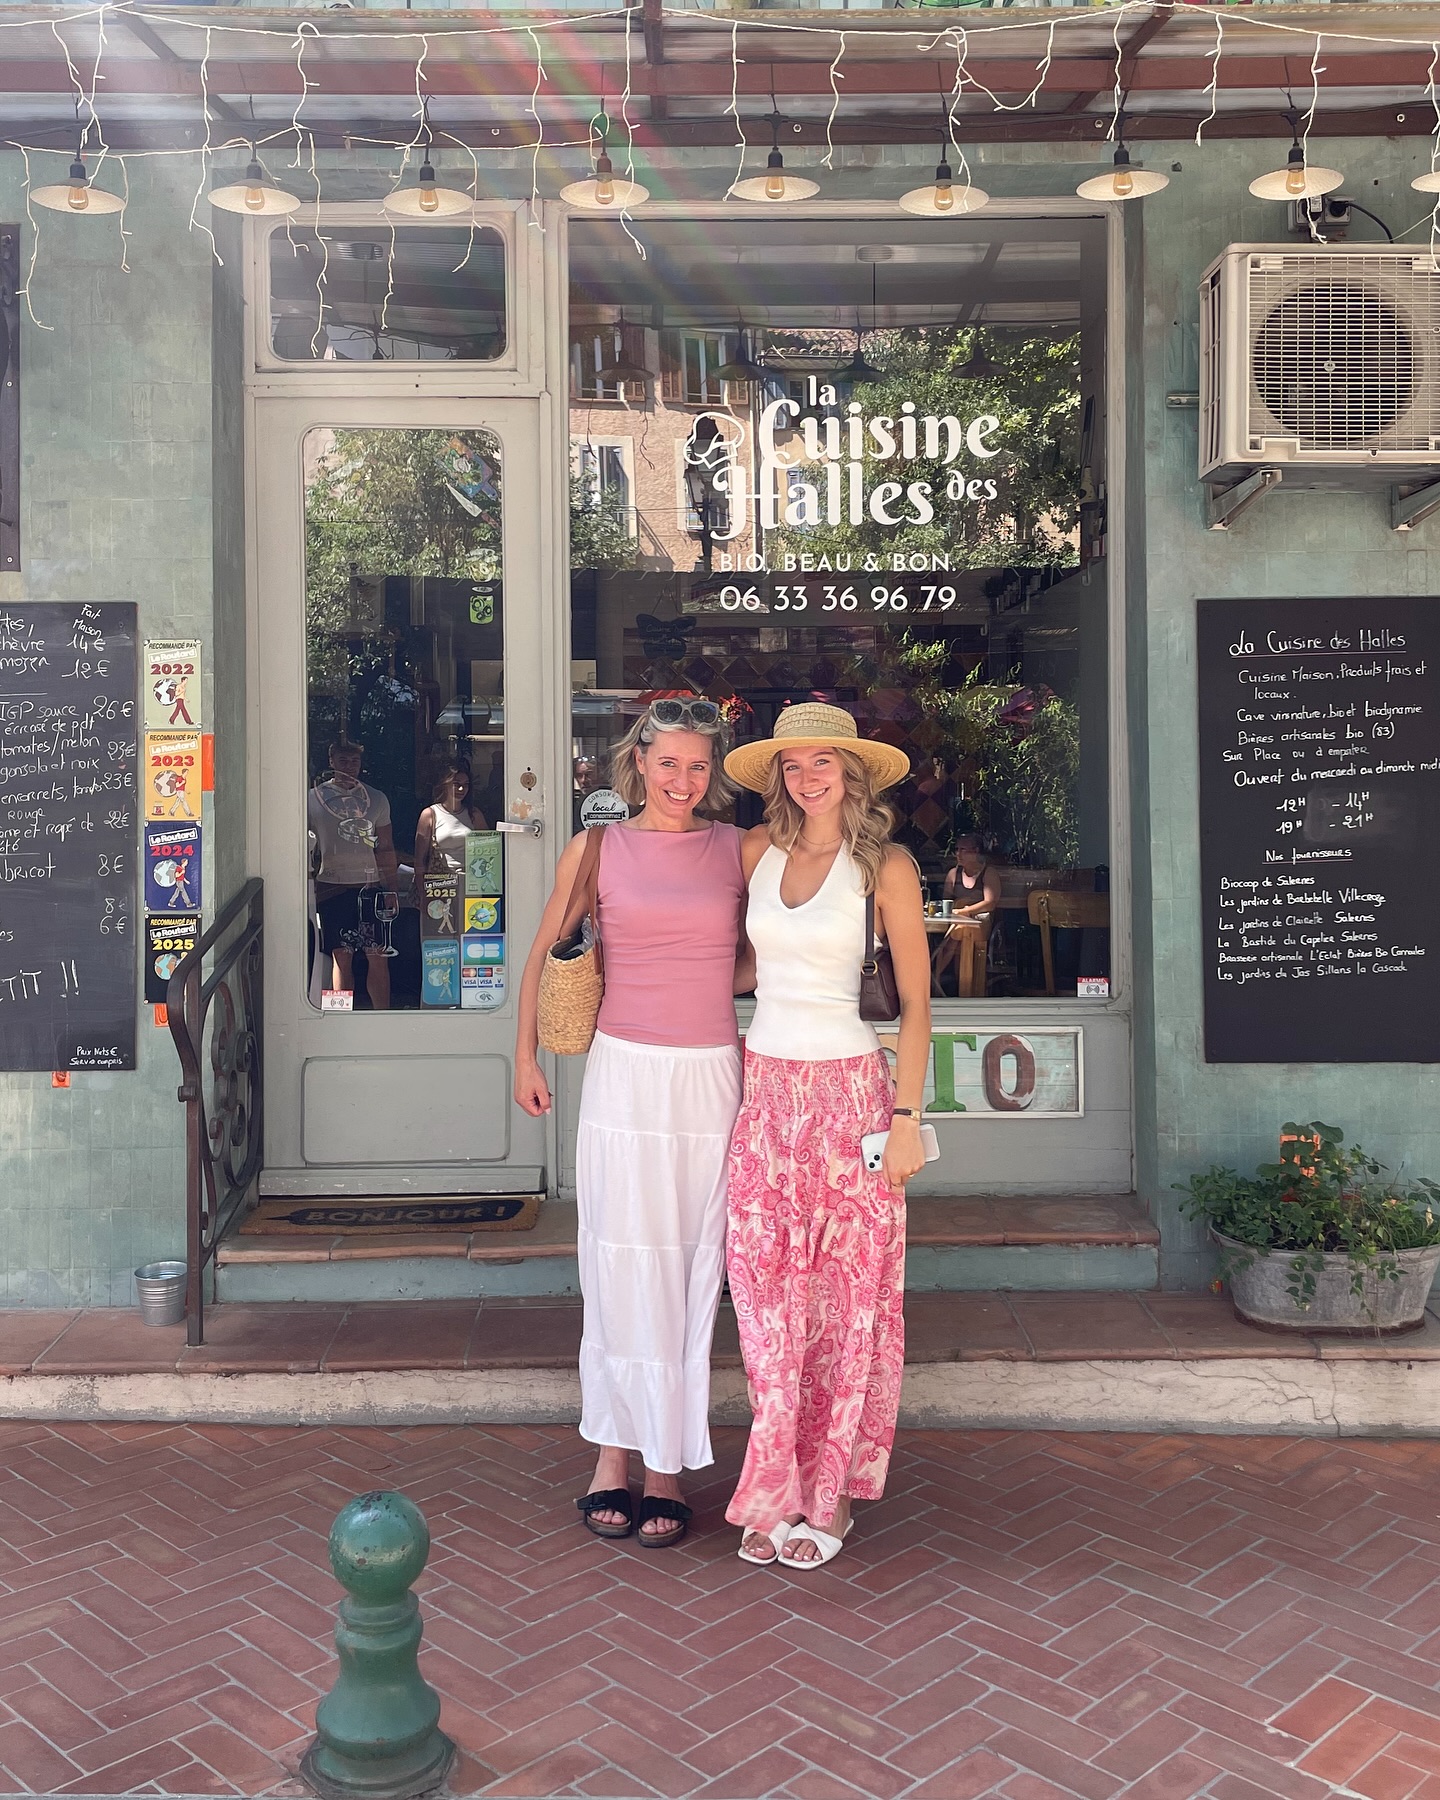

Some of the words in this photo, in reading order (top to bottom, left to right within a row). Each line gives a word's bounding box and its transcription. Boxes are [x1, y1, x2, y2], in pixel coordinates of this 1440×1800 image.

[807, 375, 838, 406] la
[759, 399, 1002, 469] Cuisine
[946, 470, 998, 501] des
[710, 460, 934, 540] Halles
[720, 553, 771, 575] BIO,
[784, 553, 851, 572] BEAU
[864, 553, 880, 572] &
[893, 553, 957, 572] BON.
[720, 586, 760, 612] 06
[774, 586, 808, 612] 33
[822, 586, 858, 612] 36
[870, 586, 906, 612] 96
[920, 586, 957, 612] 79
[81, 604, 101, 619] Fait
[72, 619, 102, 639] Maison
[0, 635, 45, 652] hèvre
[1266, 630, 1326, 653] Cuisine
[1329, 630, 1351, 649] des
[1360, 629, 1406, 651] Halles
[150, 663, 194, 675] 2022
[1238, 670, 1287, 684] Cuisine
[1385, 660, 1411, 682] frais
[1415, 660, 1427, 675] et
[36, 705, 80, 719] sauce
[1236, 708, 1265, 722] Cave
[1364, 700, 1423, 721] biodynamie
[1281, 728, 1336, 741] artisanales
[1345, 723, 1364, 739] bio
[151, 755, 194, 767] 2023
[1254, 748, 1281, 761] Place
[71, 757, 100, 770] noix
[1234, 768, 1285, 787] Ouvert
[1291, 768, 1307, 782] du
[1360, 767, 1373, 775] au
[1375, 760, 1415, 774] dimanche
[592, 802, 616, 812] local
[81, 812, 94, 831] de
[151, 836, 161, 844] Le
[160, 830, 196, 842] Routard
[150, 845, 194, 857] 2024
[468, 848, 499, 856] 2023
[1265, 850, 1284, 862] Nos
[1220, 876, 1259, 893] Biocoop
[1261, 876, 1273, 887] de
[426, 889, 457, 897] 2025
[1220, 894, 1235, 907] Les
[1236, 896, 1269, 914] jardins
[1272, 893, 1283, 905] de
[161, 926, 195, 936] Routard
[1219, 917, 1235, 930] Les
[1238, 918, 1269, 934] jardins
[1272, 915, 1283, 927] de
[152, 939, 195, 950] 2025
[1217, 937, 1230, 948] La
[1241, 935, 1276, 948] Bastide
[1283, 933, 1296, 945] du
[426, 957, 455, 966] 2024
[1219, 952, 1257, 963] Brasserie
[1261, 950, 1303, 962] artisanale
[1375, 947, 1388, 958] Bio
[1217, 967, 1233, 980] Les
[1291, 966, 1311, 978] Jas
[1317, 964, 1351, 976] Sillans
[1356, 961, 1366, 975] la
[305, 1206, 483, 1222] BONJOUR
